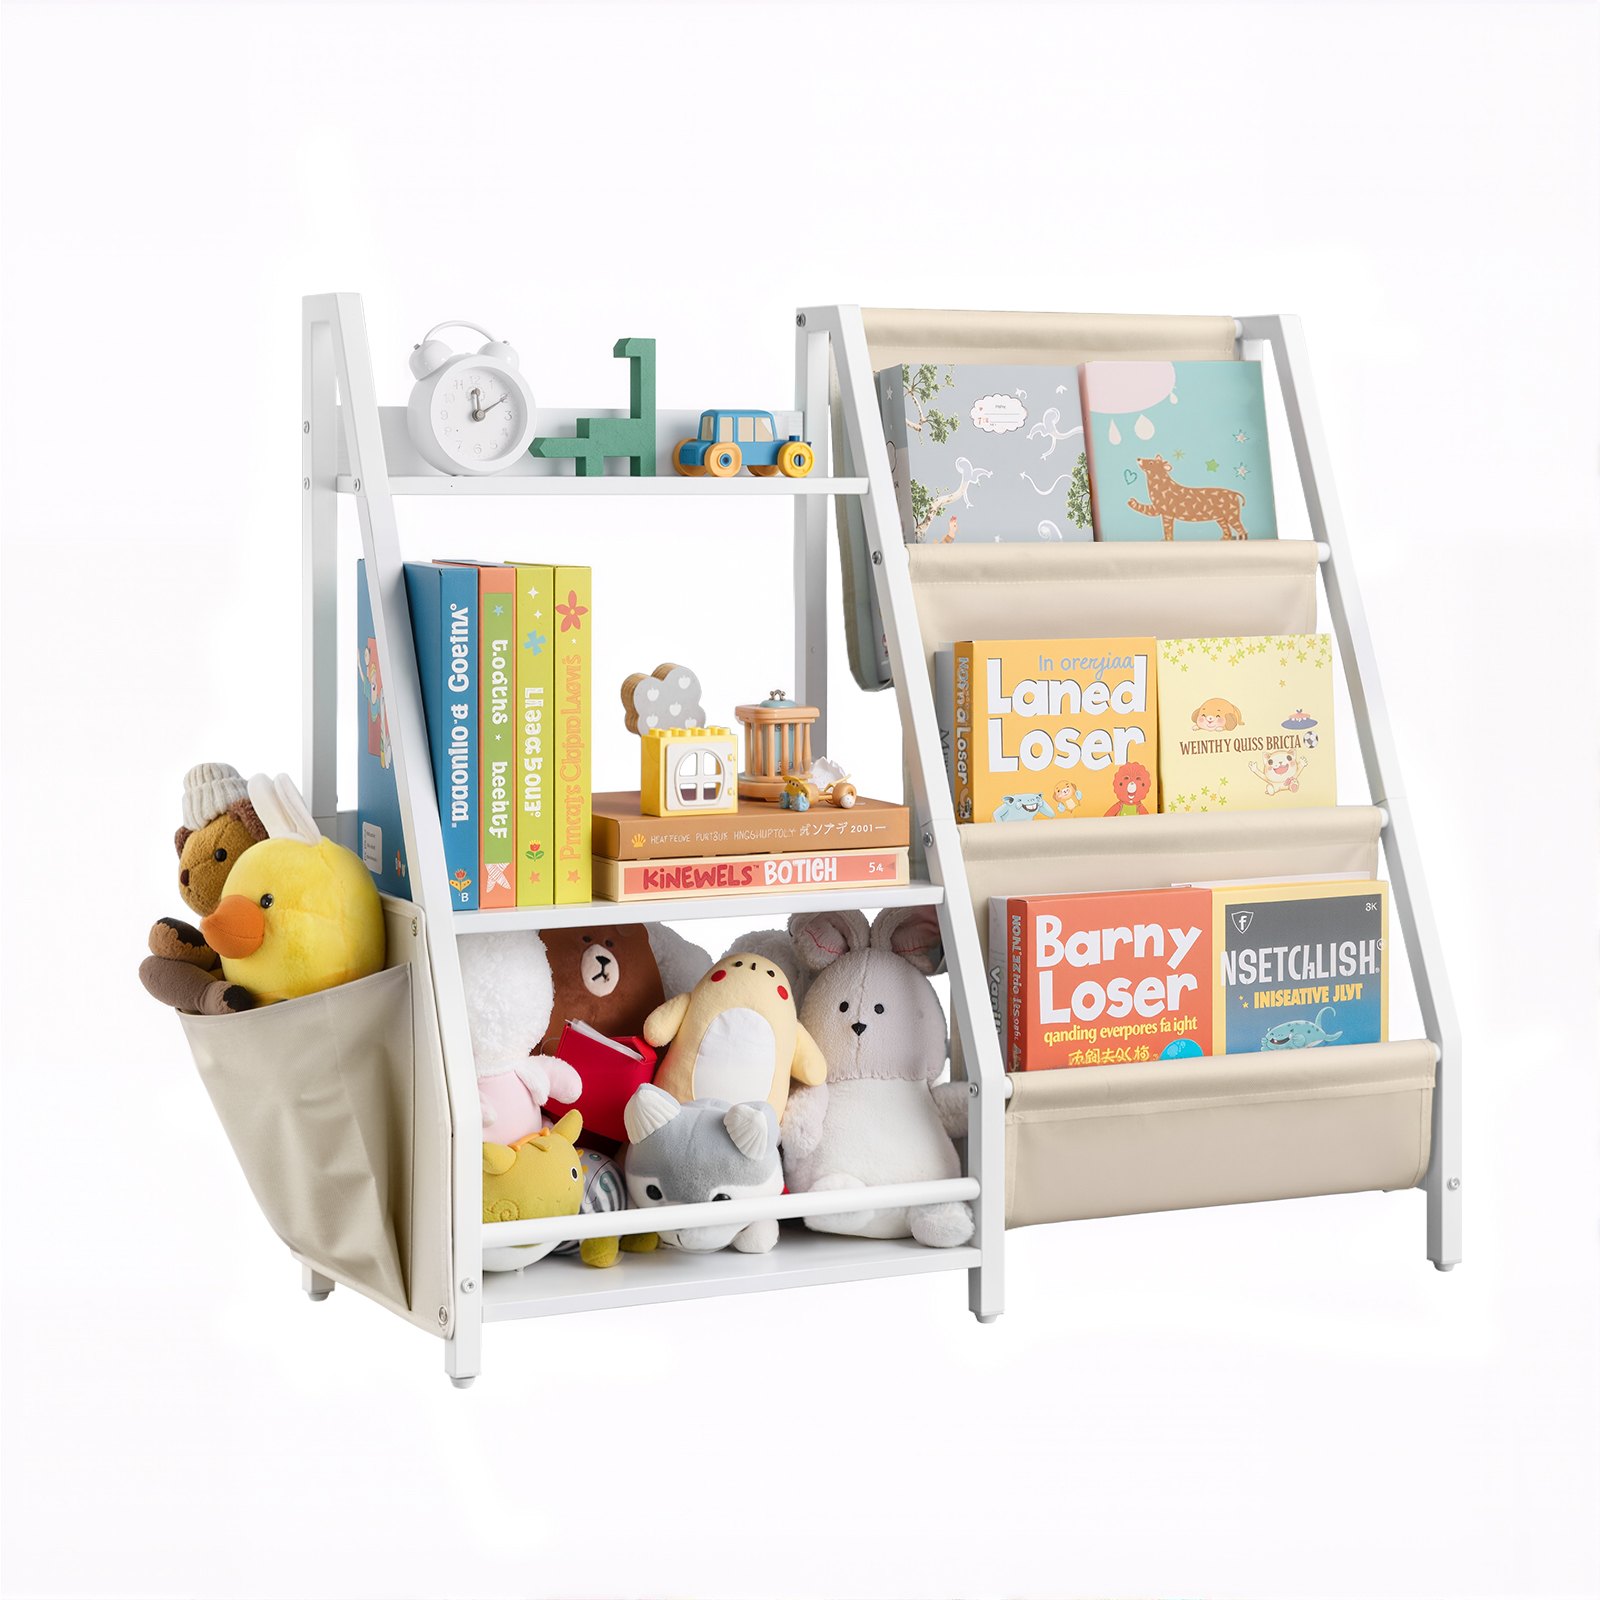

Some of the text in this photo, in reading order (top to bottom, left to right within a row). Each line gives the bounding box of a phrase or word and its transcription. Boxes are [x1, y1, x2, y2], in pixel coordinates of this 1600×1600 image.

[986, 654, 1147, 718] Laned
[1038, 655, 1054, 671] In
[987, 717, 1146, 773] Loser
[1233, 736, 1264, 753] QUISS
[1035, 914, 1203, 971] Barny
[1039, 969, 1199, 1024] Loser
